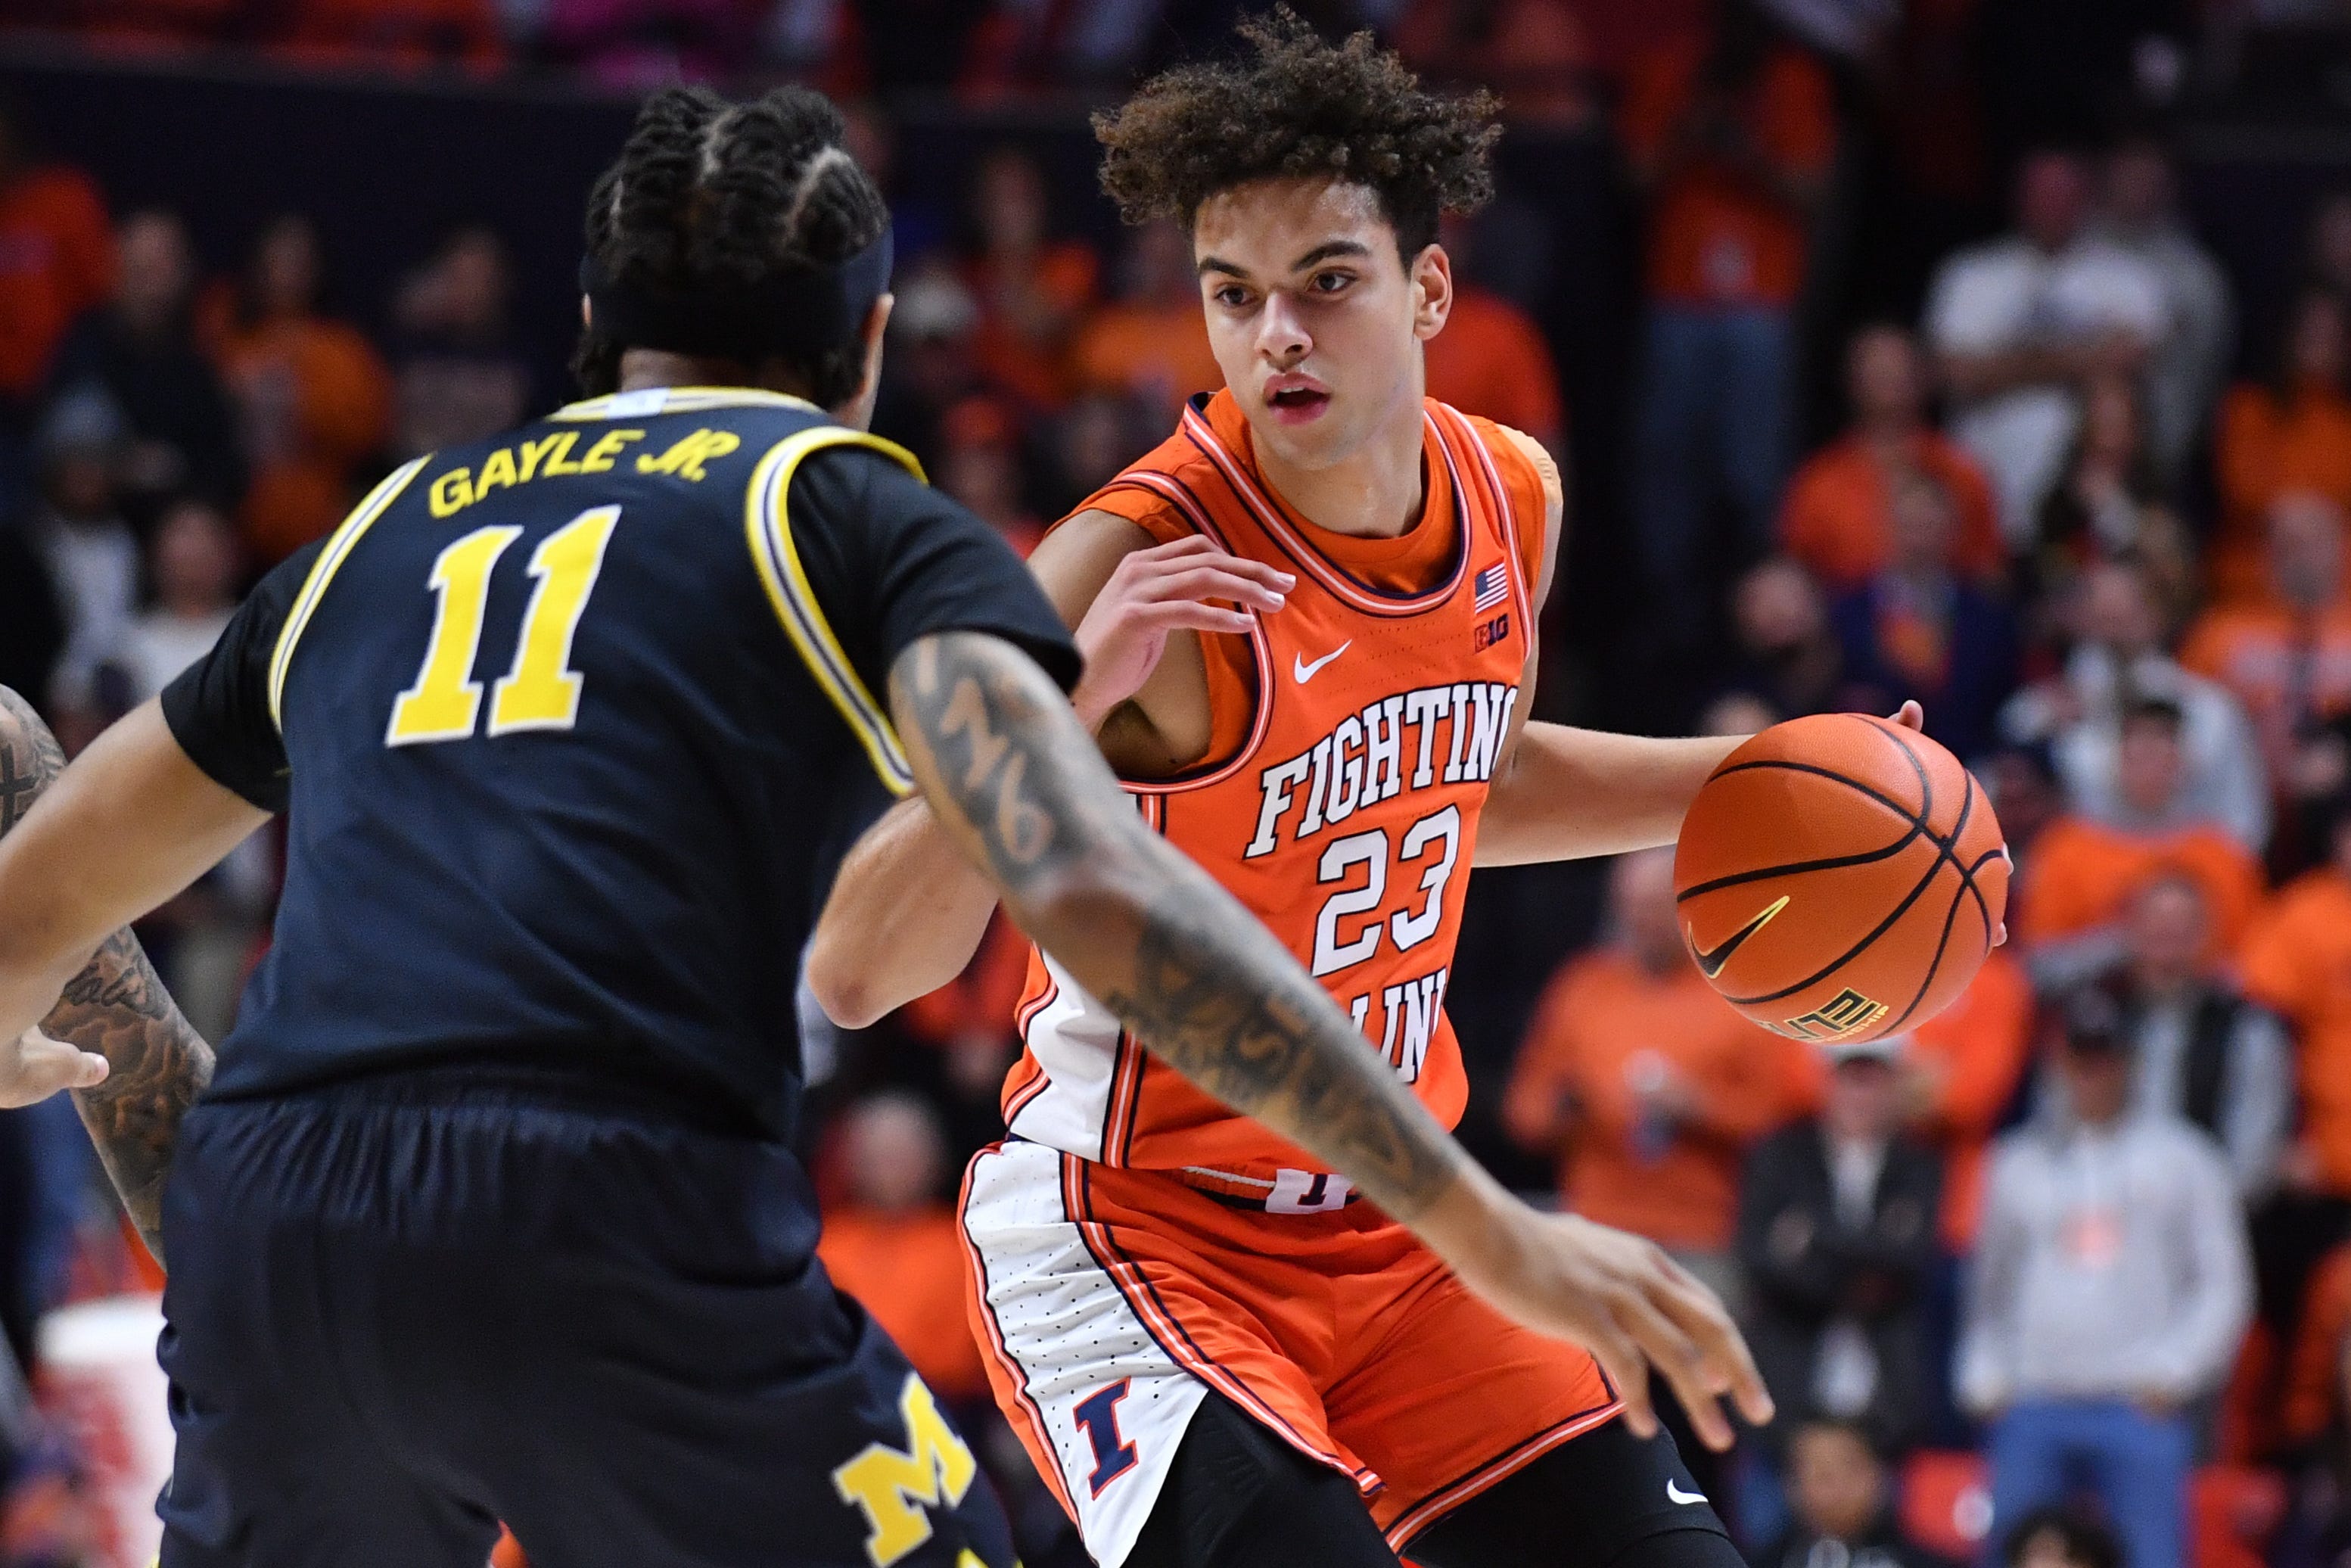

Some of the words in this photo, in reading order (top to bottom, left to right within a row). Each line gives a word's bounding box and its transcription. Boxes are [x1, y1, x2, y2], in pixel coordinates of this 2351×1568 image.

[429, 431, 645, 518] GAYLE
[385, 504, 622, 748] 11
[1311, 803, 1460, 978] 23
[833, 1370, 977, 1568] M
[1072, 1376, 1139, 1501] I
